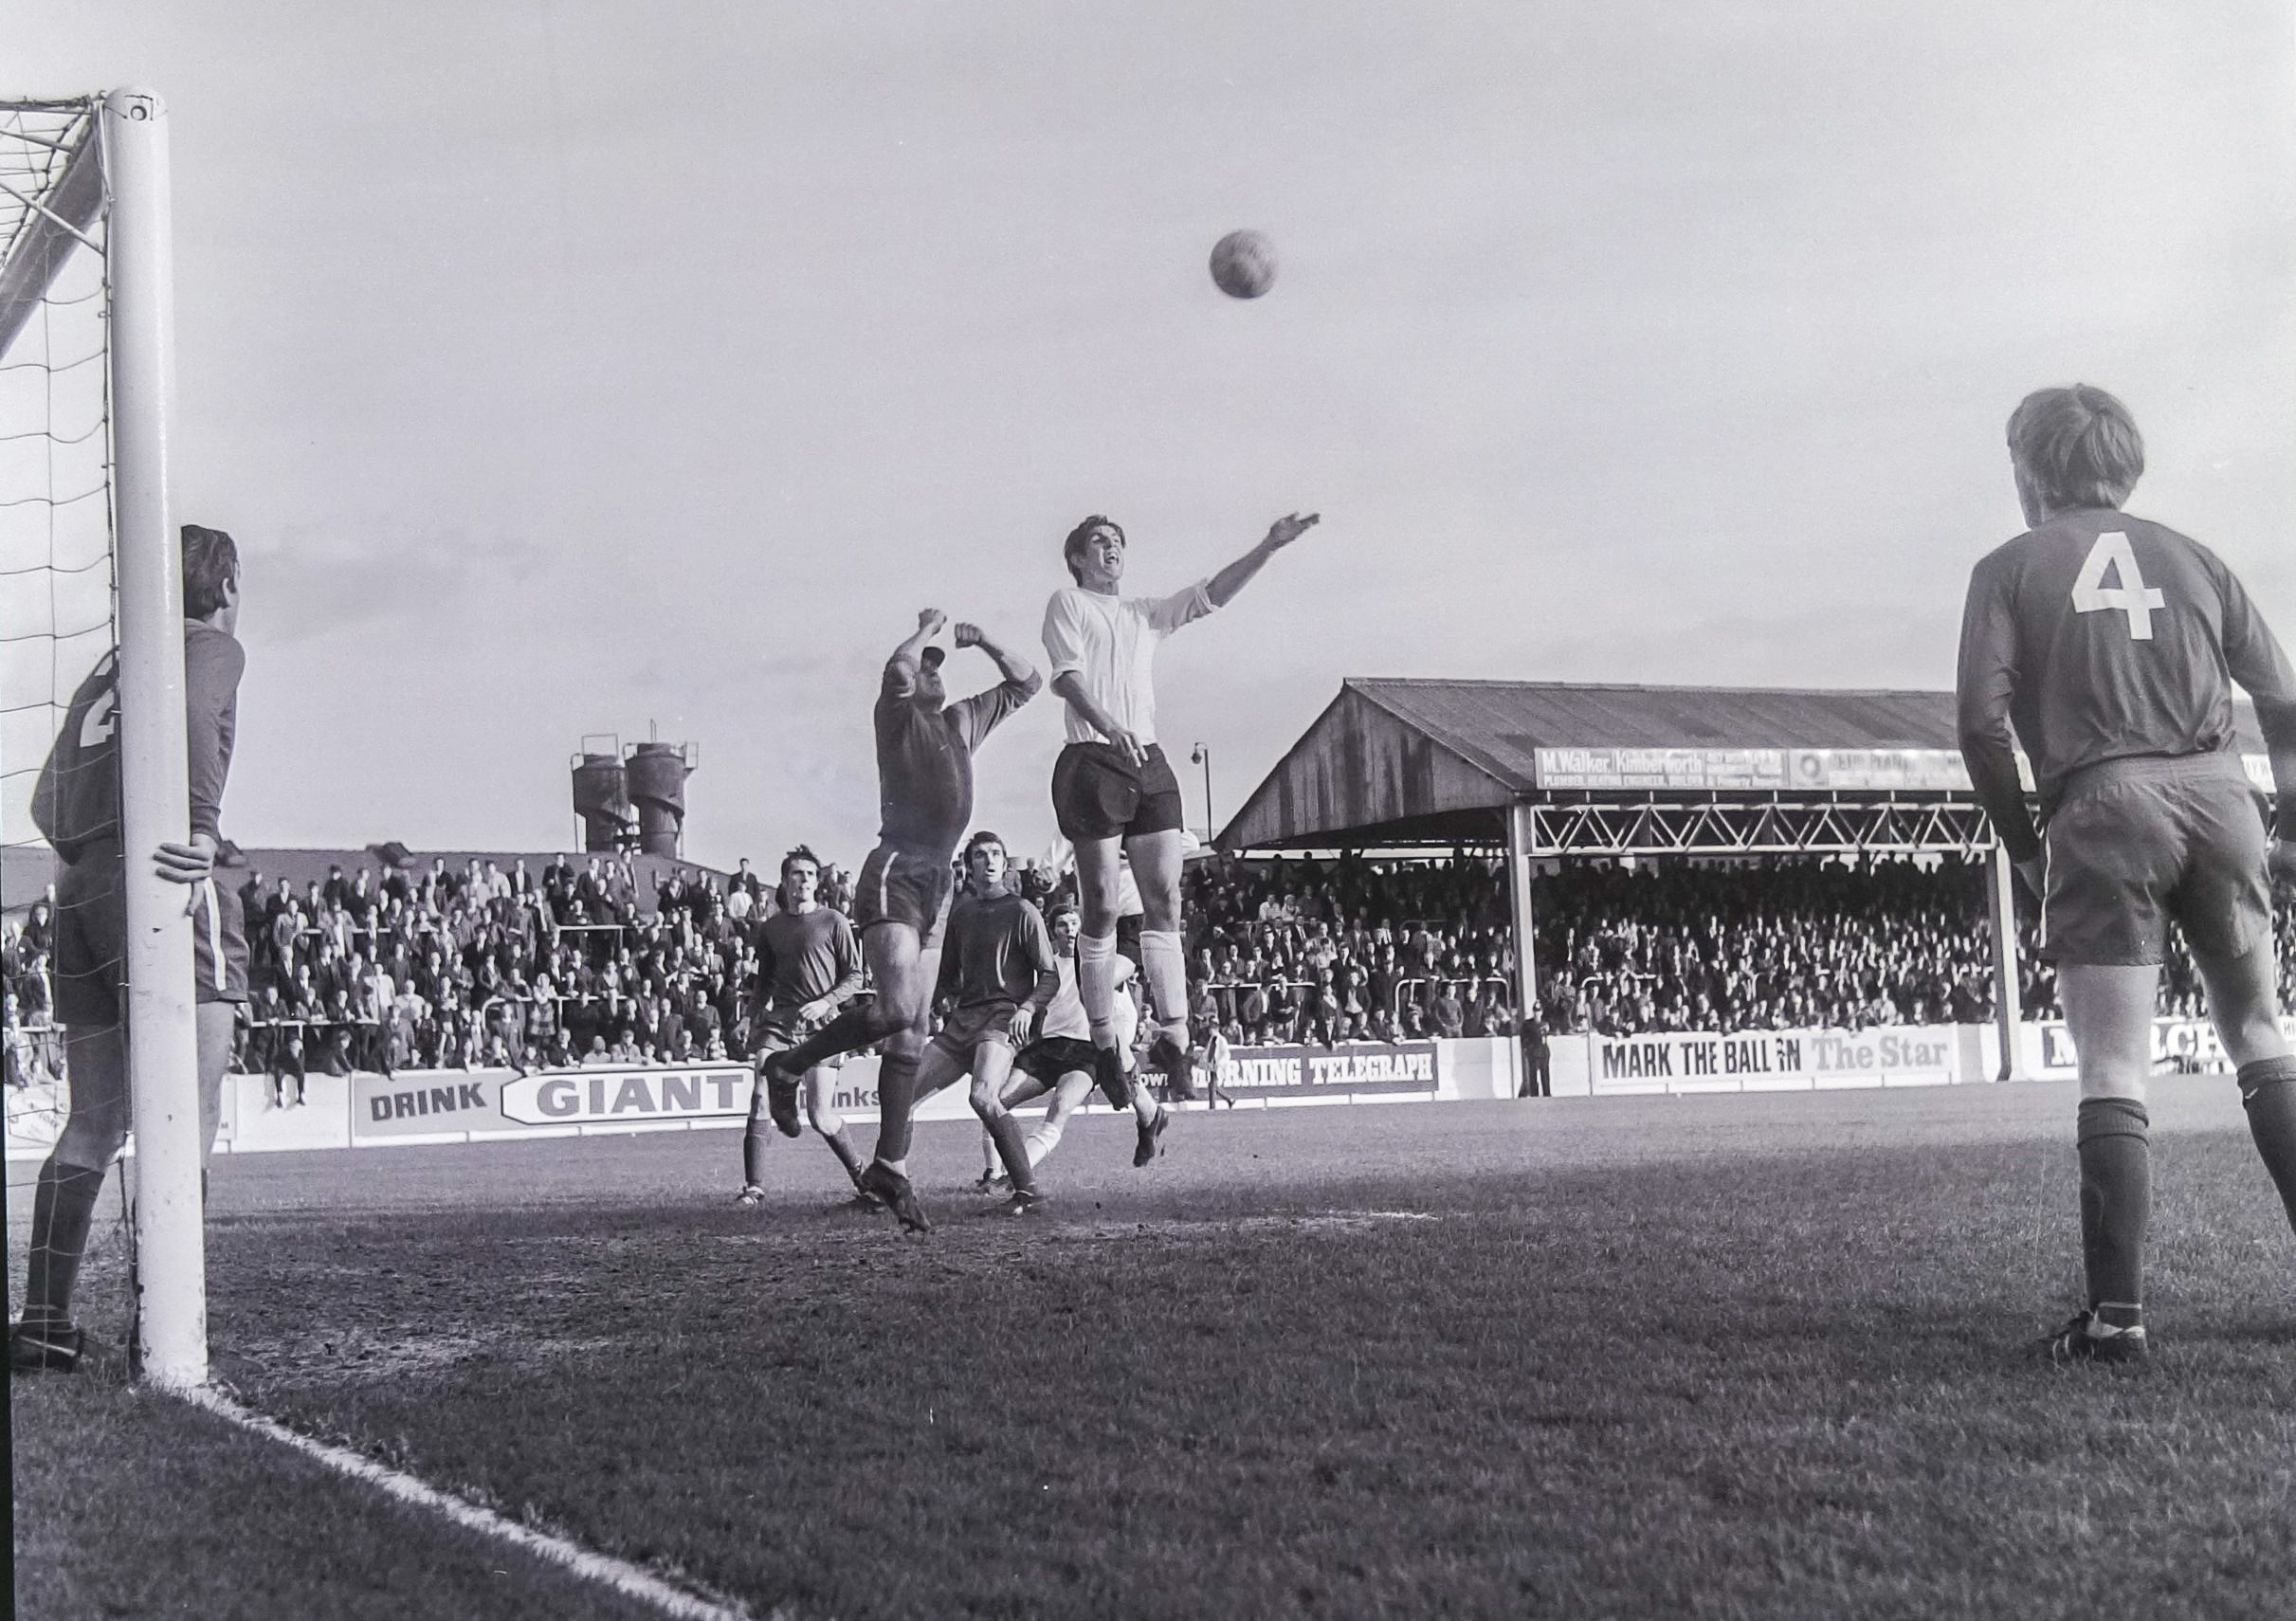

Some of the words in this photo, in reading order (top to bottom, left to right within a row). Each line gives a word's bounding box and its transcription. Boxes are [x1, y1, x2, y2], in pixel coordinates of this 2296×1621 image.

[2070, 531, 2166, 640] 4
[1308, 1053, 1433, 1084] TELEGRAPH
[1602, 1042, 1672, 1078] MARK
[1680, 1040, 1719, 1076] THE
[1723, 1039, 1772, 1073] BALL
[1811, 1037, 1874, 1070] The
[1879, 1035, 1948, 1067] Star
[371, 1082, 487, 1121] DRINK
[536, 1073, 744, 1117] GIANT
